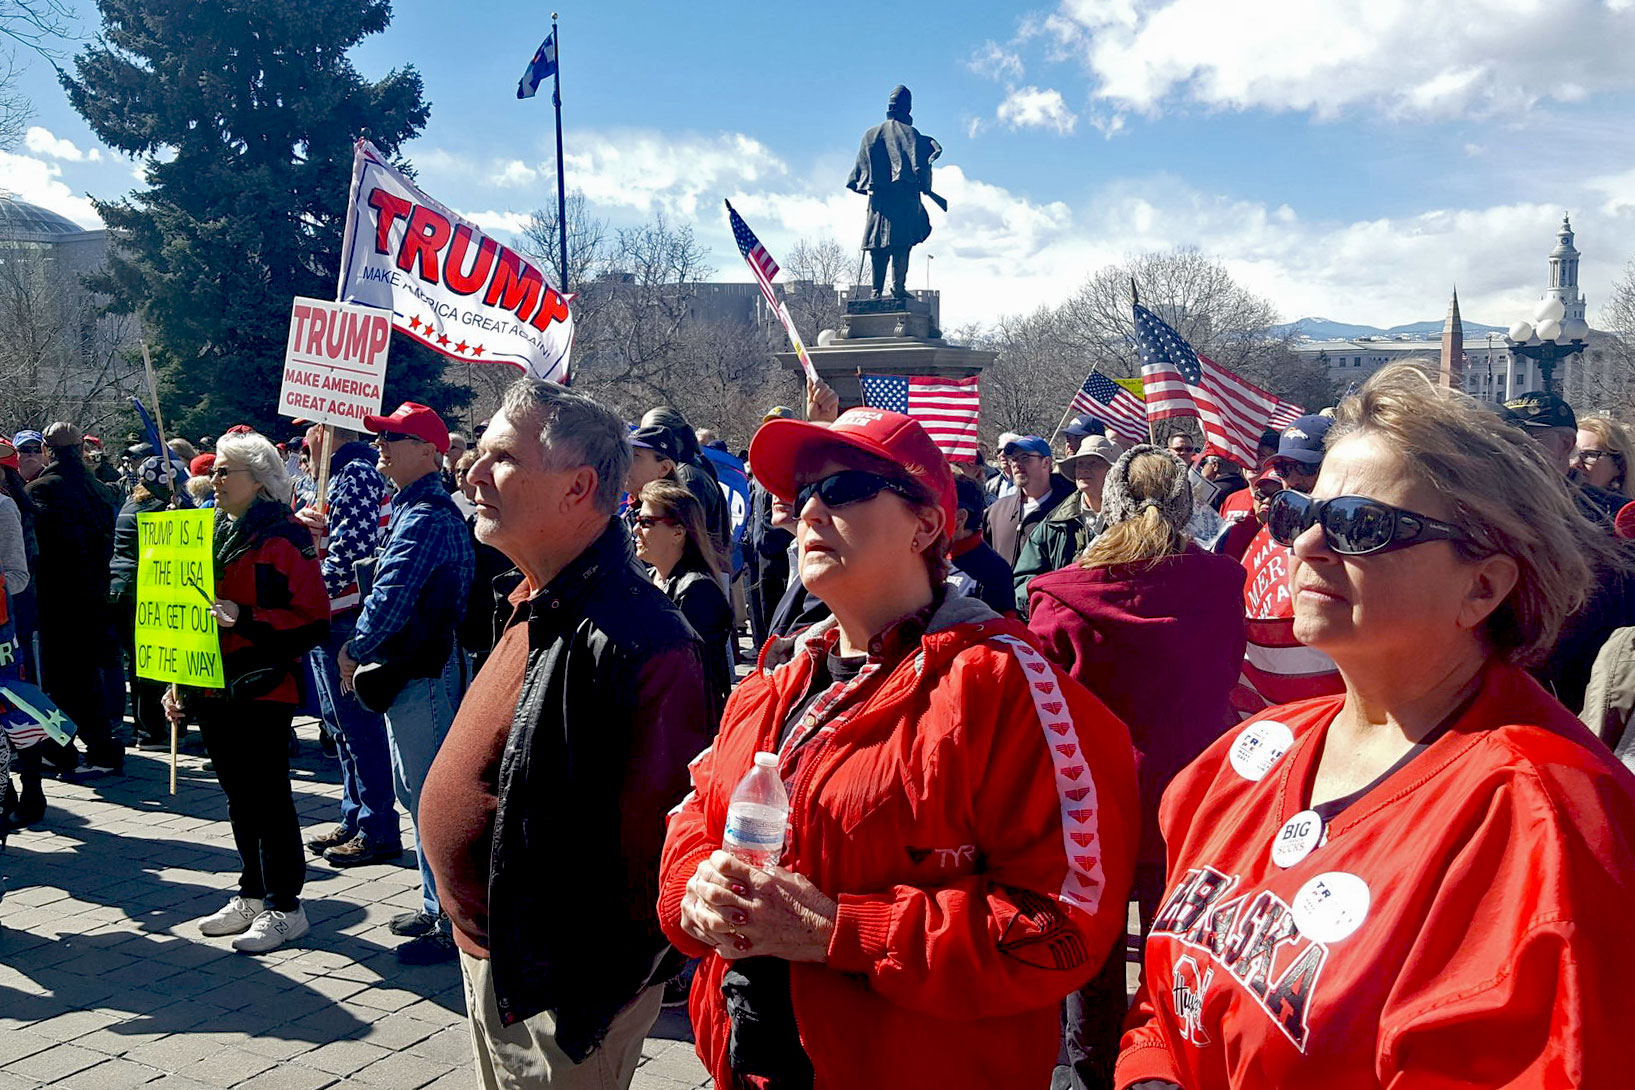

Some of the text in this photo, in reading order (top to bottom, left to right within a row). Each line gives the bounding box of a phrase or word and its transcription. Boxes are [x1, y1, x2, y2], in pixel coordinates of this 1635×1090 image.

[367, 187, 570, 333] TRUMP
[362, 266, 402, 287] MAKE
[461, 311, 509, 335] GREAT
[509, 325, 552, 361] AGAIN!
[293, 304, 389, 366] TRUMP
[284, 368, 380, 400] MAKE AMERICA
[286, 391, 327, 413] GREAT
[141, 519, 204, 546] TRUMP IS 4
[153, 560, 204, 587] THE USA
[166, 604, 187, 630] GET
[191, 605, 218, 634] OUT
[138, 644, 216, 678] OF THE WAY
[1282, 821, 1312, 840] BIG
[934, 844, 975, 868] TYR
